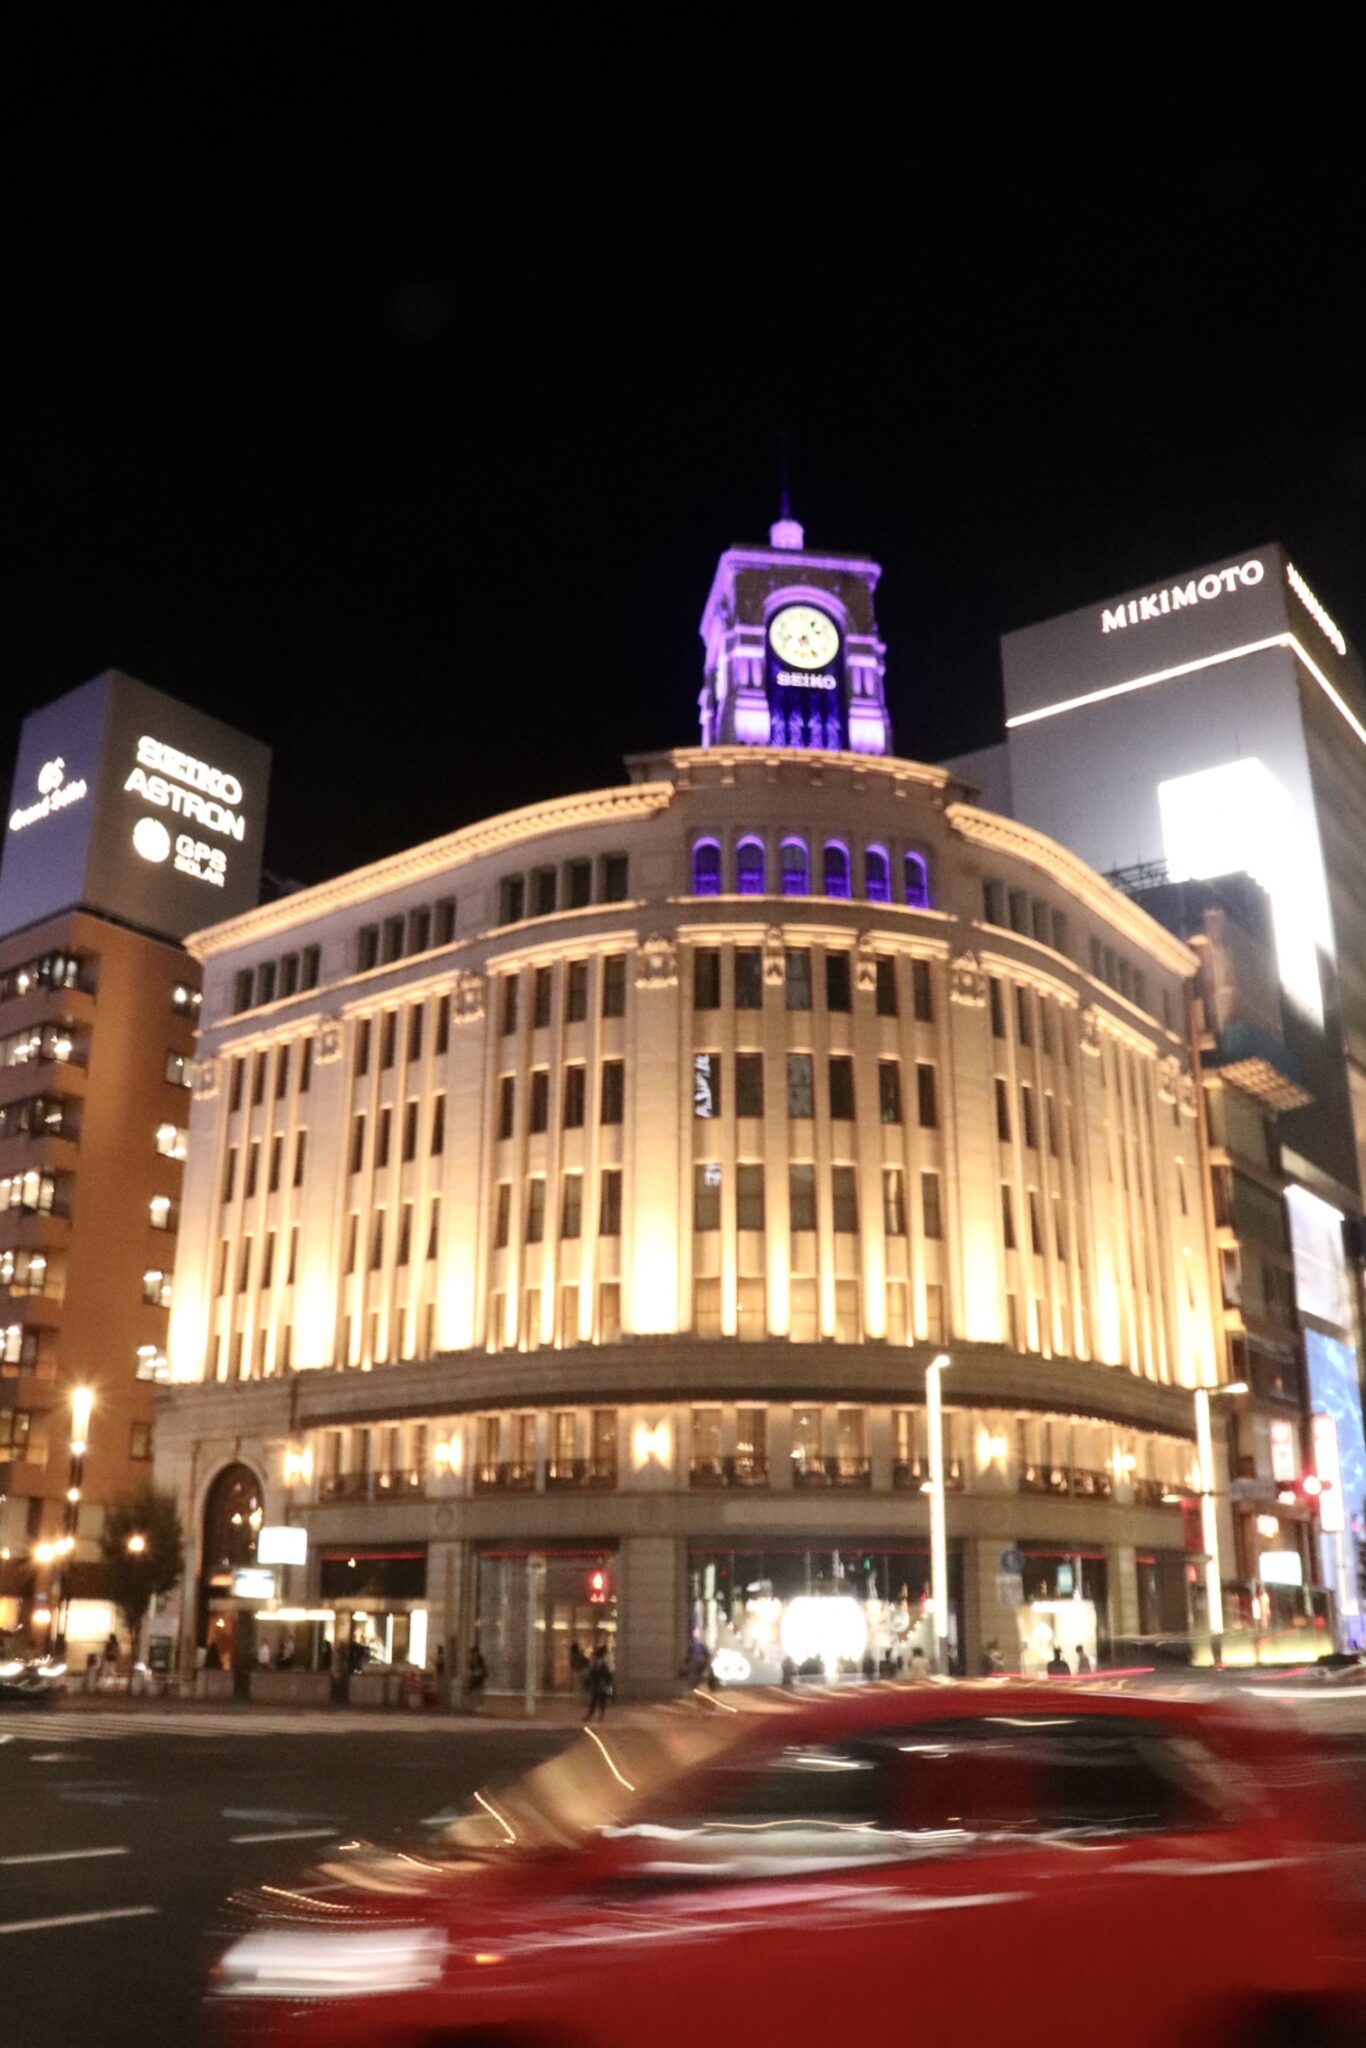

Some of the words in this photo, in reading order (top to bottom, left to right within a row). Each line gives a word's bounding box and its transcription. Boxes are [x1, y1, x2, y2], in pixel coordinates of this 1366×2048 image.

[1101, 560, 1264, 633] MIKIMOTO
[776, 671, 836, 690] SEIKO
[123, 767, 245, 841] ASTRON
[136, 735, 243, 805] SEIKO
[175, 834, 227, 873] GPS
